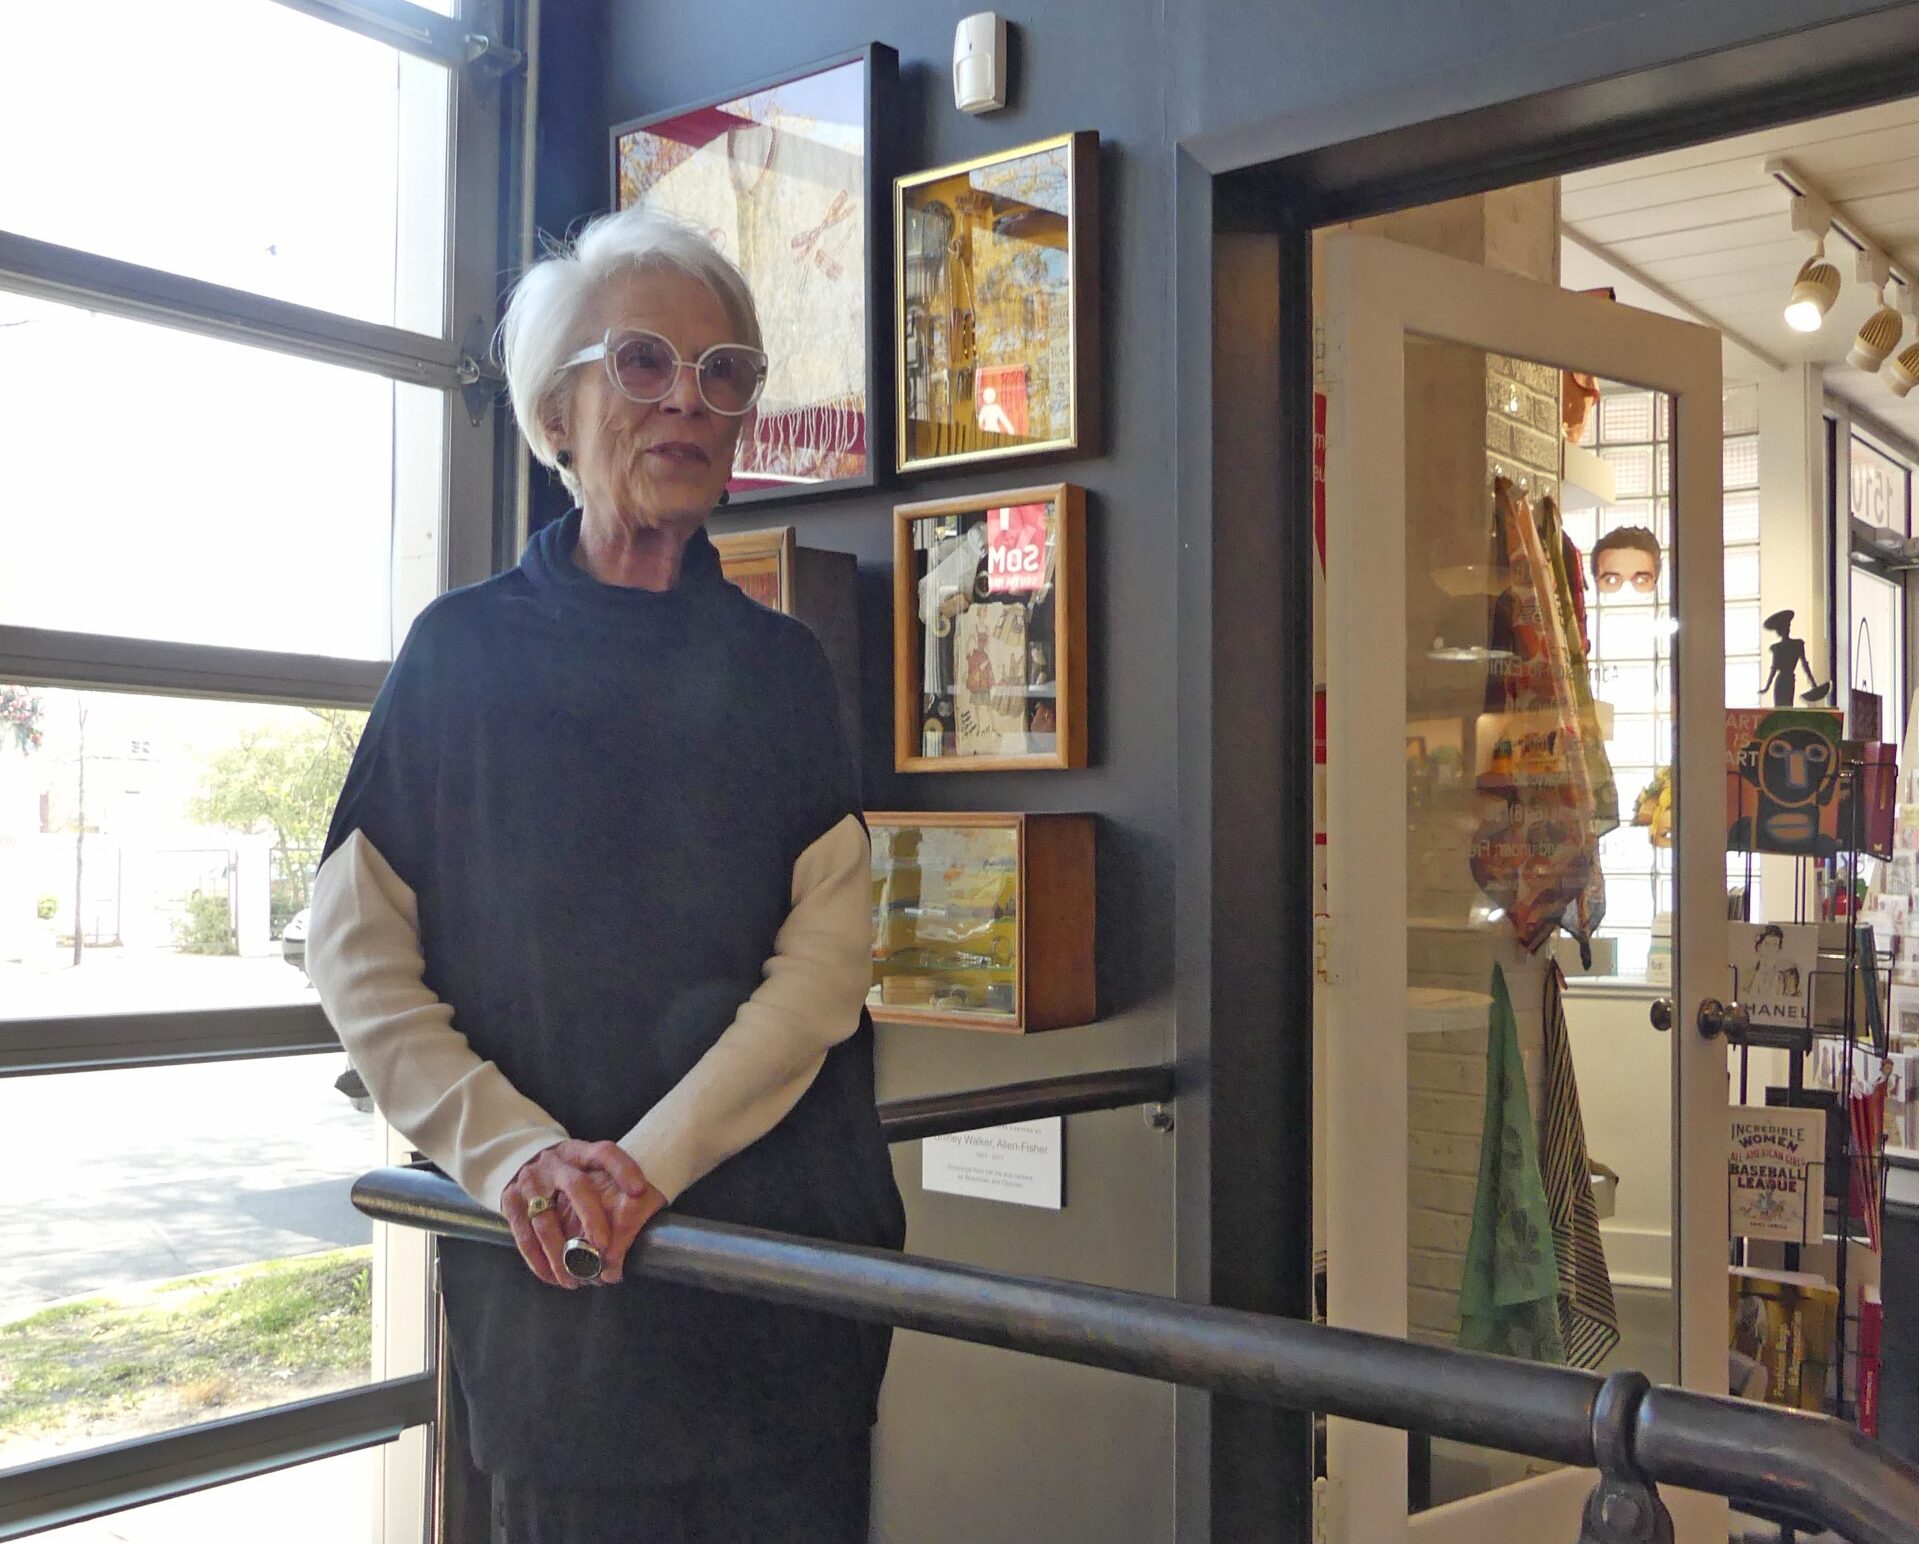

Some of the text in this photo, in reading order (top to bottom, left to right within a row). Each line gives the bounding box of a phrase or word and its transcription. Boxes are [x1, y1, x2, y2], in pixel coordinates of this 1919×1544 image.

[1727, 715, 1760, 730] ART
[1725, 751, 1759, 767] ART
[1744, 1003, 1807, 1019] HANEL
[1731, 1123, 1805, 1142] INCREDIBLE
[964, 1135, 994, 1148] Walker,
[997, 1139, 1048, 1154] Allen-Fisher
[1738, 1134, 1799, 1153] WOMEN
[1730, 1164, 1807, 1180] BASEBALL
[1737, 1176, 1798, 1193] LEAGUE
